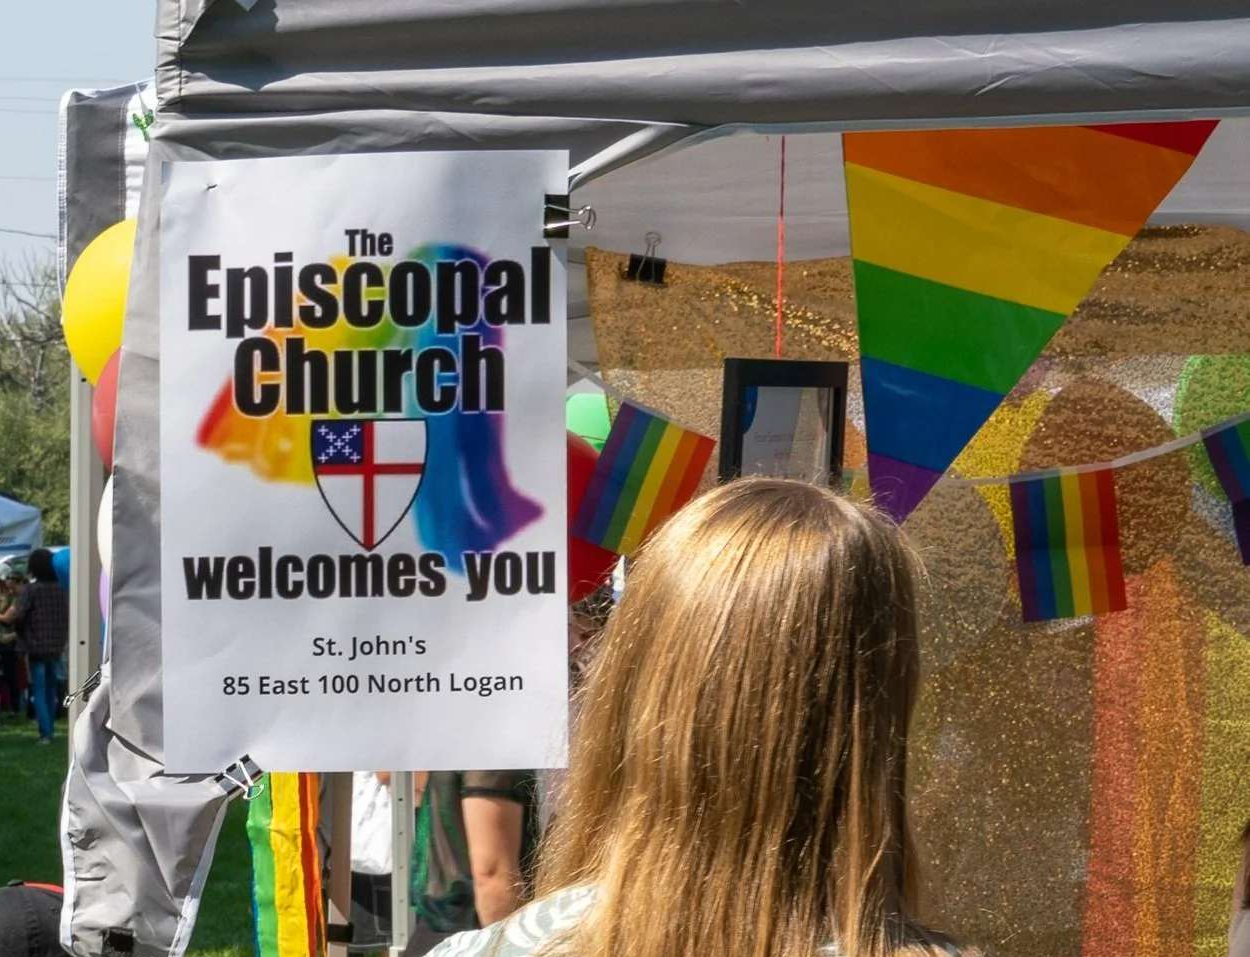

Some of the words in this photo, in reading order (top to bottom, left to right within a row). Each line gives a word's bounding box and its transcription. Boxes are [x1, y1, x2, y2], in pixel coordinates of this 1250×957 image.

[344, 228, 394, 257] The
[188, 246, 552, 339] Episcopal
[233, 333, 506, 417] Church
[182, 546, 447, 601] welcomes
[463, 550, 557, 602] you
[312, 637, 343, 657] St.
[348, 635, 427, 661] John's
[222, 676, 250, 695] 85
[258, 675, 310, 695] East
[317, 674, 360, 695] 100
[367, 672, 441, 694] North
[449, 672, 525, 697] Logan
